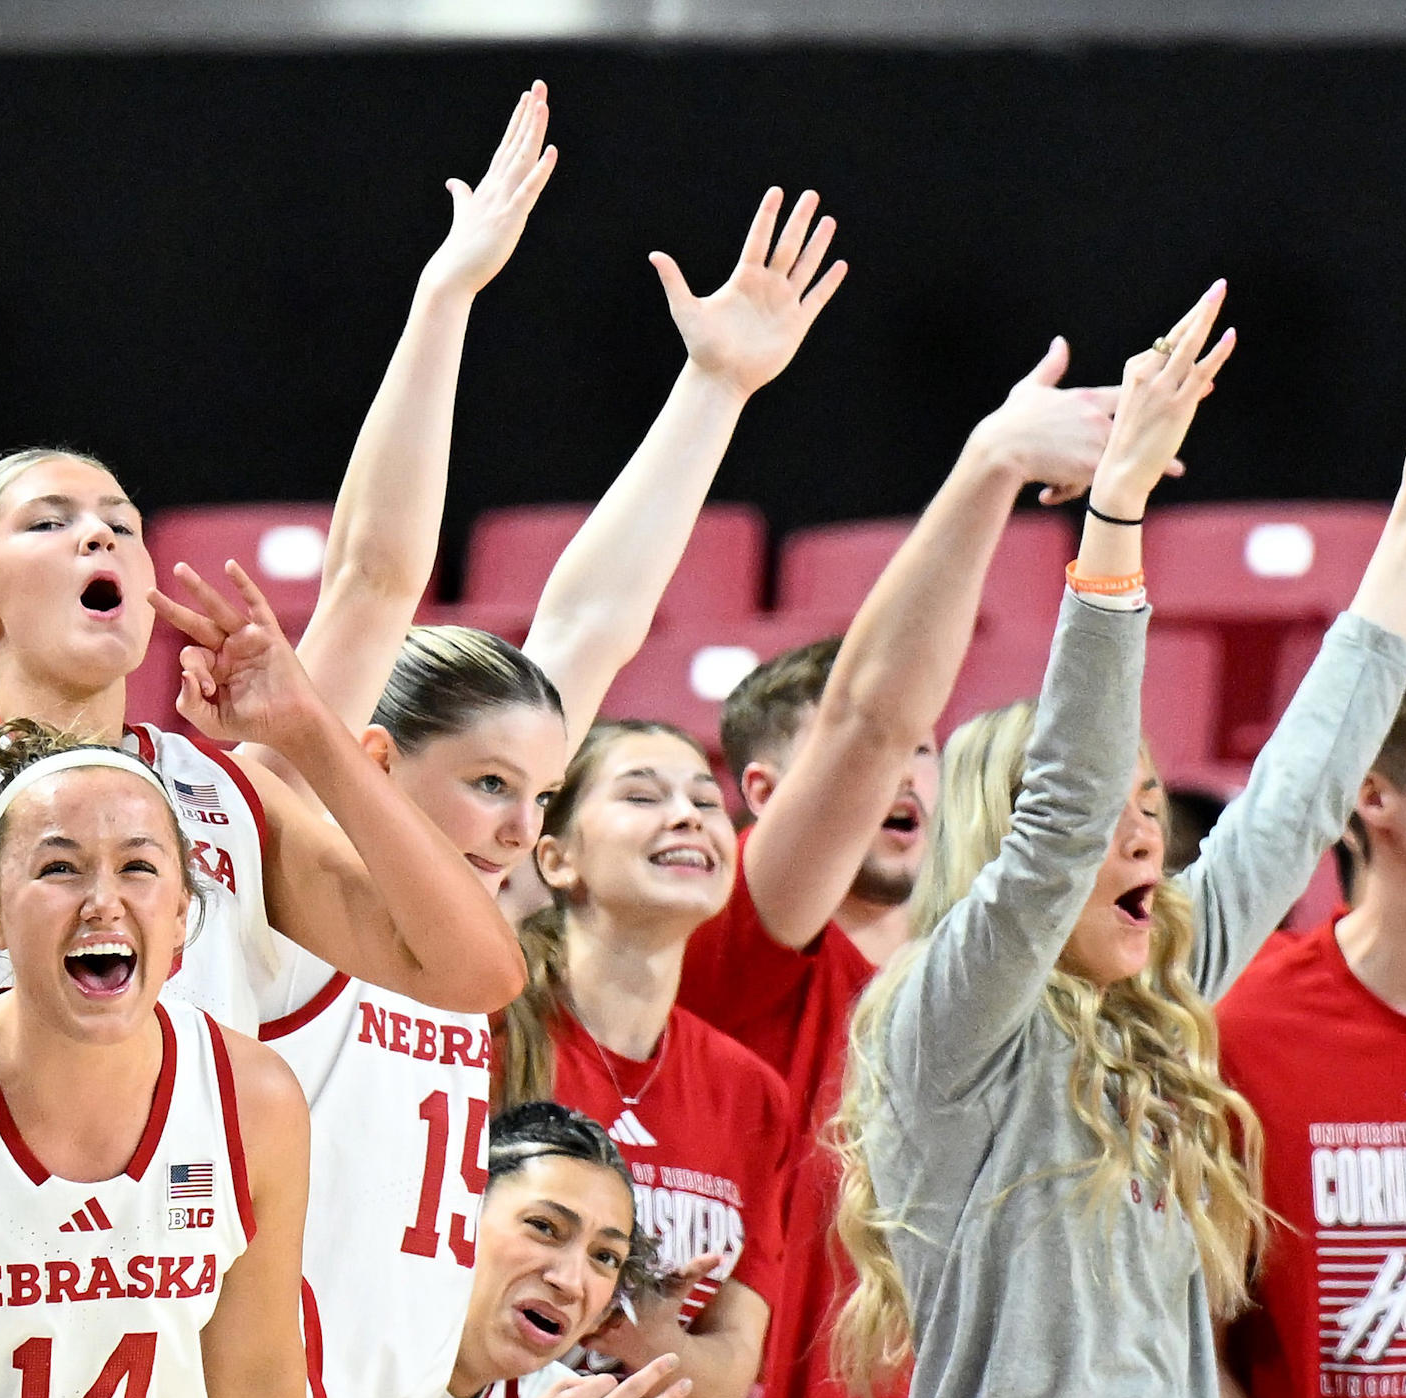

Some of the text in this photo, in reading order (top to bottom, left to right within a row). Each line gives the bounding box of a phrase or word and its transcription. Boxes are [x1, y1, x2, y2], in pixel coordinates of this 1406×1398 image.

[358, 1001, 490, 1072] NEBRA
[400, 1089, 489, 1269] 15
[631, 1162, 655, 1185] OF
